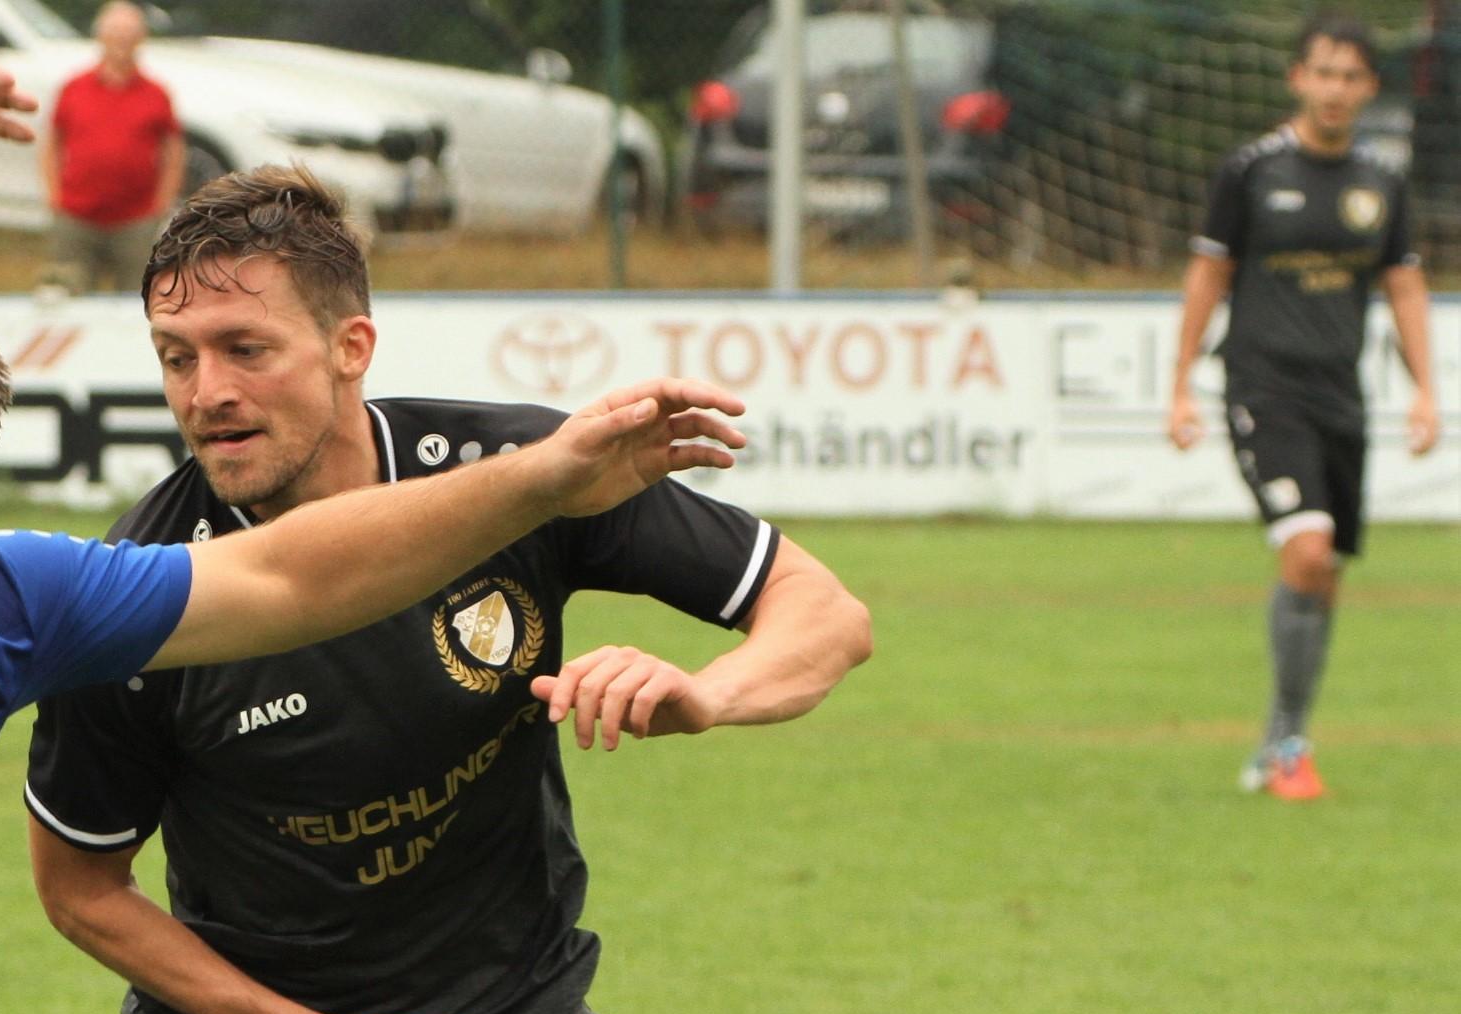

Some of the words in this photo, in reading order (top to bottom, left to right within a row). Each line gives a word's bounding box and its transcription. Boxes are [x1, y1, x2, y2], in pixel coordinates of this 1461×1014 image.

[652, 321, 1005, 391] TOYOTA
[688, 405, 1032, 483] shändler
[238, 692, 308, 735] JAKO
